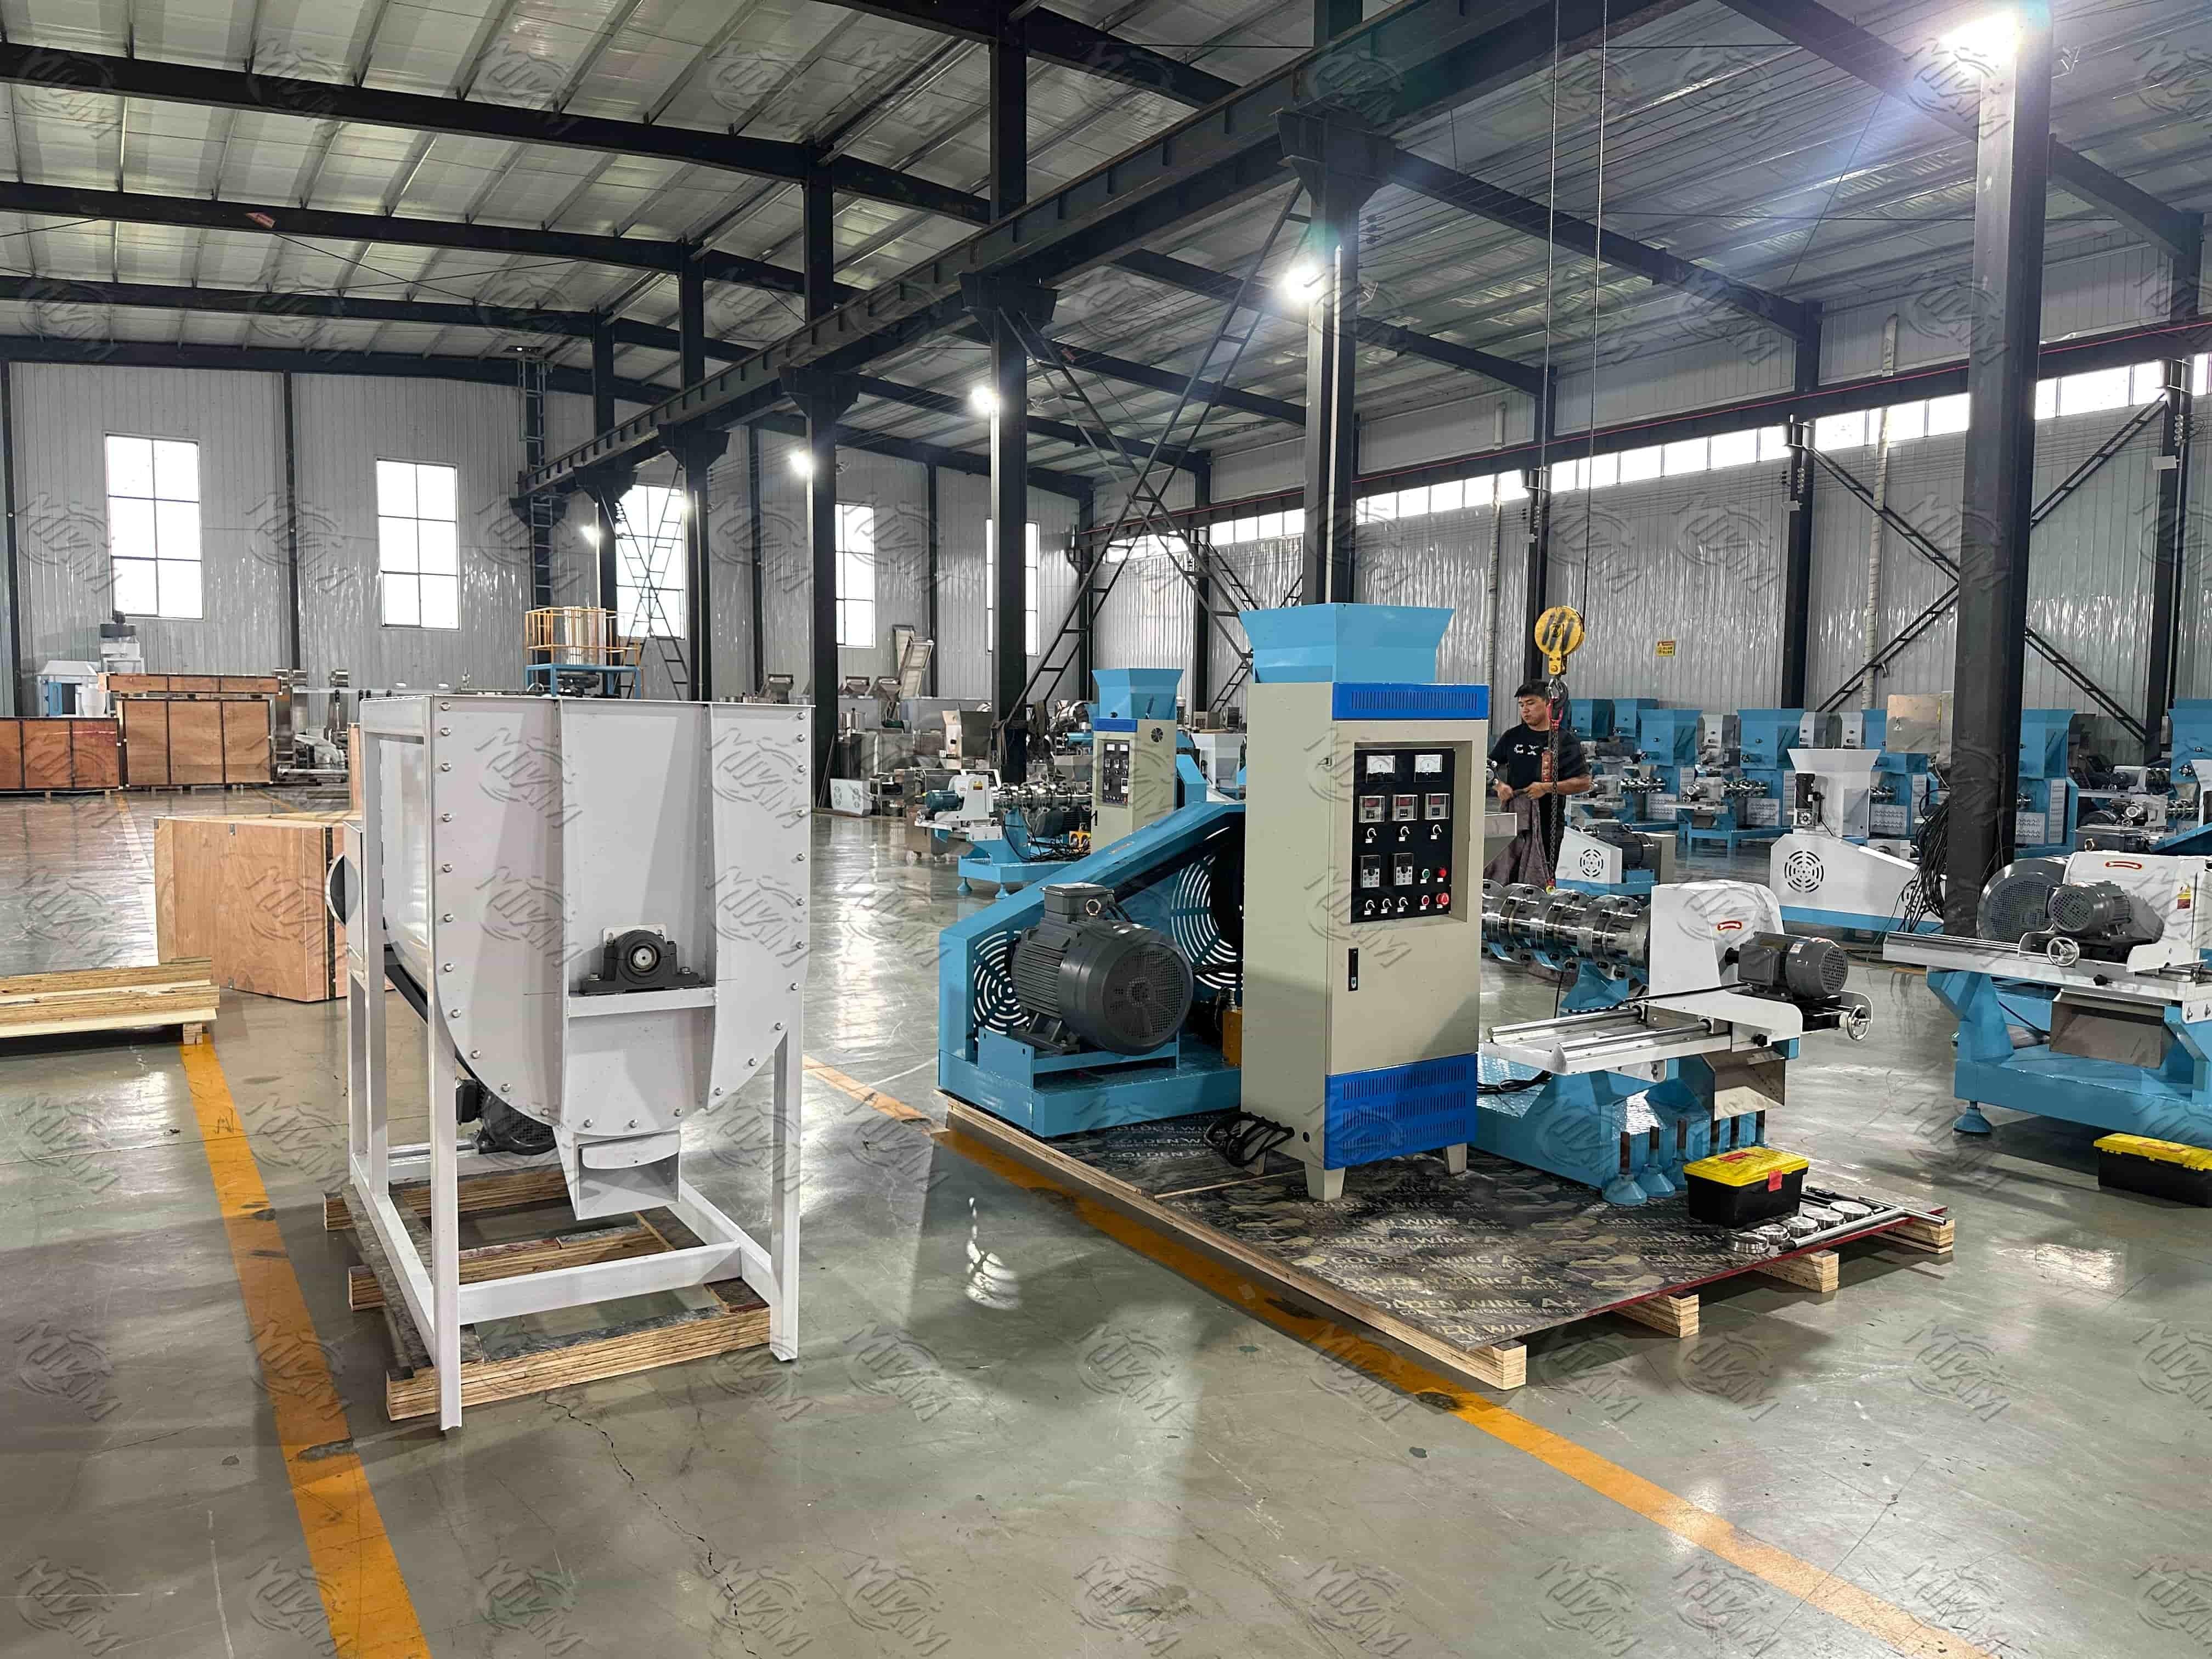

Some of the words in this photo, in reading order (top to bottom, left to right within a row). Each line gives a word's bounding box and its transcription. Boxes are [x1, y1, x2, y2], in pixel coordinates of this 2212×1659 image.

[1644, 1254, 1737, 1262] GOLDEN
[1521, 1275, 1559, 1285] A+
[1462, 1299, 1532, 1308] WING
[1541, 1297, 1581, 1308] A+
